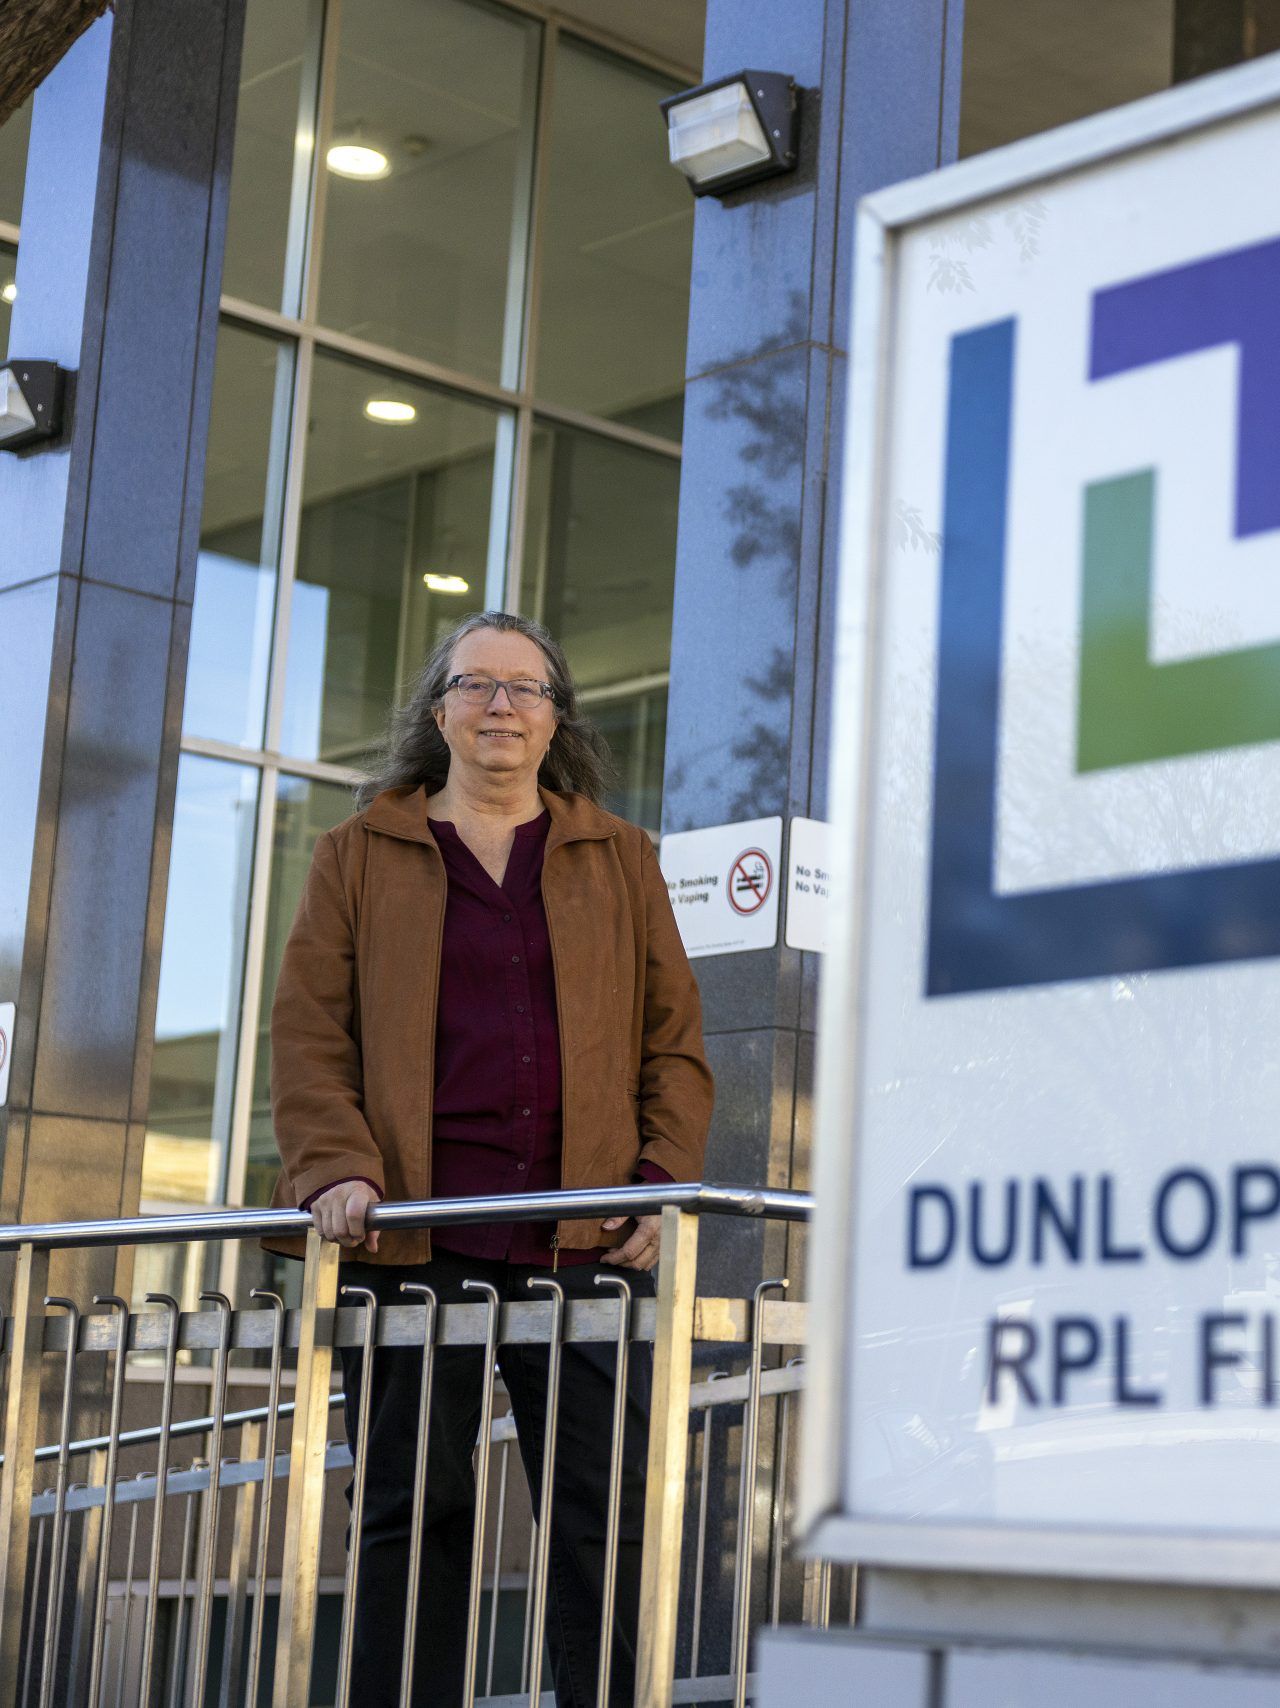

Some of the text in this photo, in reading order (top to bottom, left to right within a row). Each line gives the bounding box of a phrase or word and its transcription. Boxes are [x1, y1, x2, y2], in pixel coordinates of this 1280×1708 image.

[795, 865, 811, 877] No
[679, 874, 719, 889] Smoking
[795, 880, 810, 893] No
[678, 892, 710, 906] Vaping
[986, 1313, 1164, 1410] RPL
